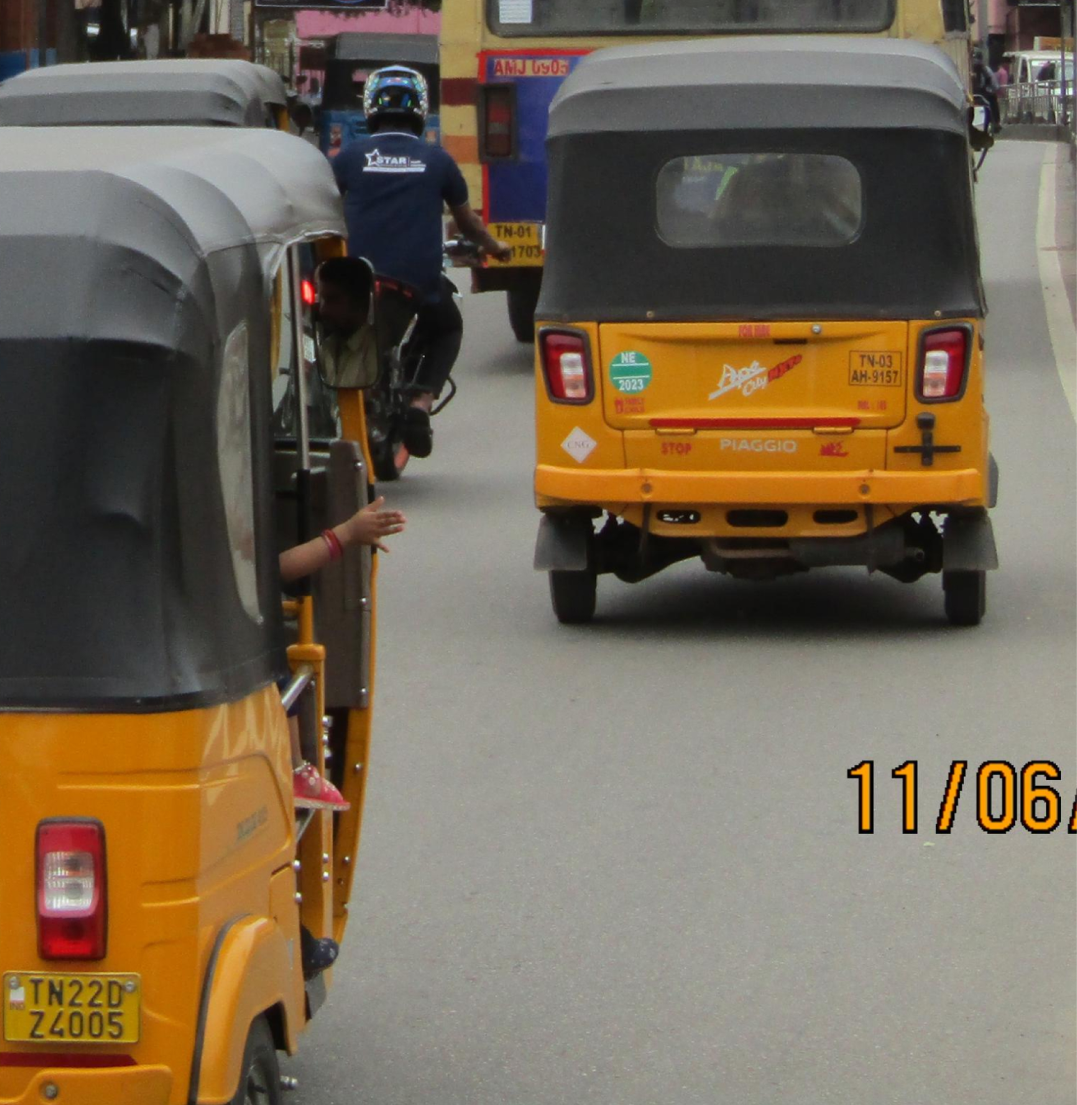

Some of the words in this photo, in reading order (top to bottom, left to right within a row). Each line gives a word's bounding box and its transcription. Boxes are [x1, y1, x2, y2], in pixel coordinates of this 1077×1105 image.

[494, 59, 526, 75] AMJ
[376, 156, 407, 165] STAR
[495, 225, 531, 238] TN-01
[621, 352, 636, 364] NE
[859, 354, 893, 368] TN-03
[851, 370, 898, 384] AH-9157
[618, 379, 644, 391] 2023
[661, 442, 692, 456] STOP
[720, 438, 798, 453] PIAGGIO
[29, 978, 124, 1008] TN22D
[29, 1009, 124, 1039] Z4005
